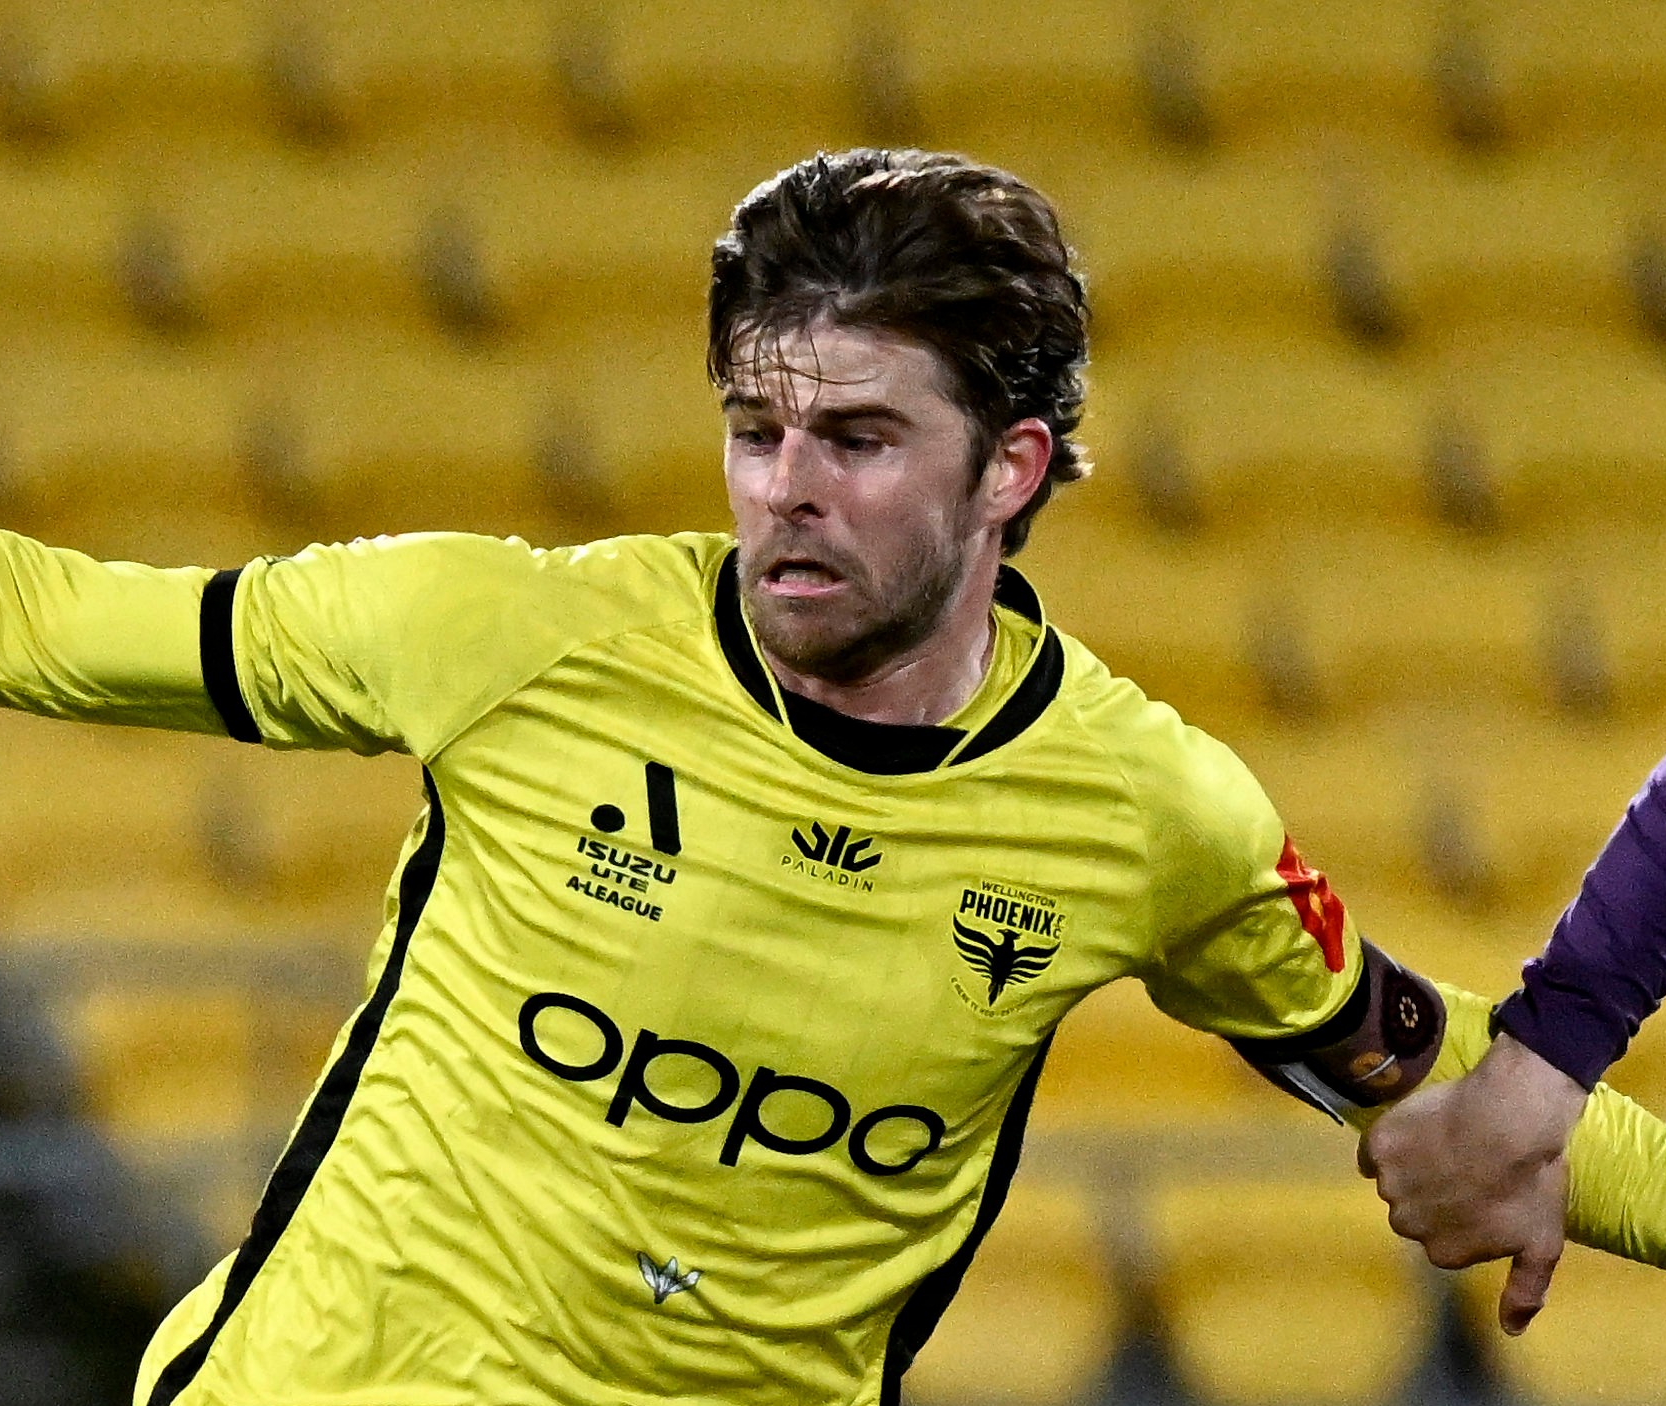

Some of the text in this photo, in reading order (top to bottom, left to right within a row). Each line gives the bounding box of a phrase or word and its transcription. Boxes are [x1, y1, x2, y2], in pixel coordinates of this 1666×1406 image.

[576, 836, 677, 884] ISUZU
[590, 863, 649, 894] UTE
[780, 855, 874, 892] PALADIN
[565, 875, 664, 922] A-LEAGUE
[959, 889, 1056, 938] PHOENIX
[981, 881, 1057, 908] WELLINGTON
[517, 991, 947, 1177] oppo
